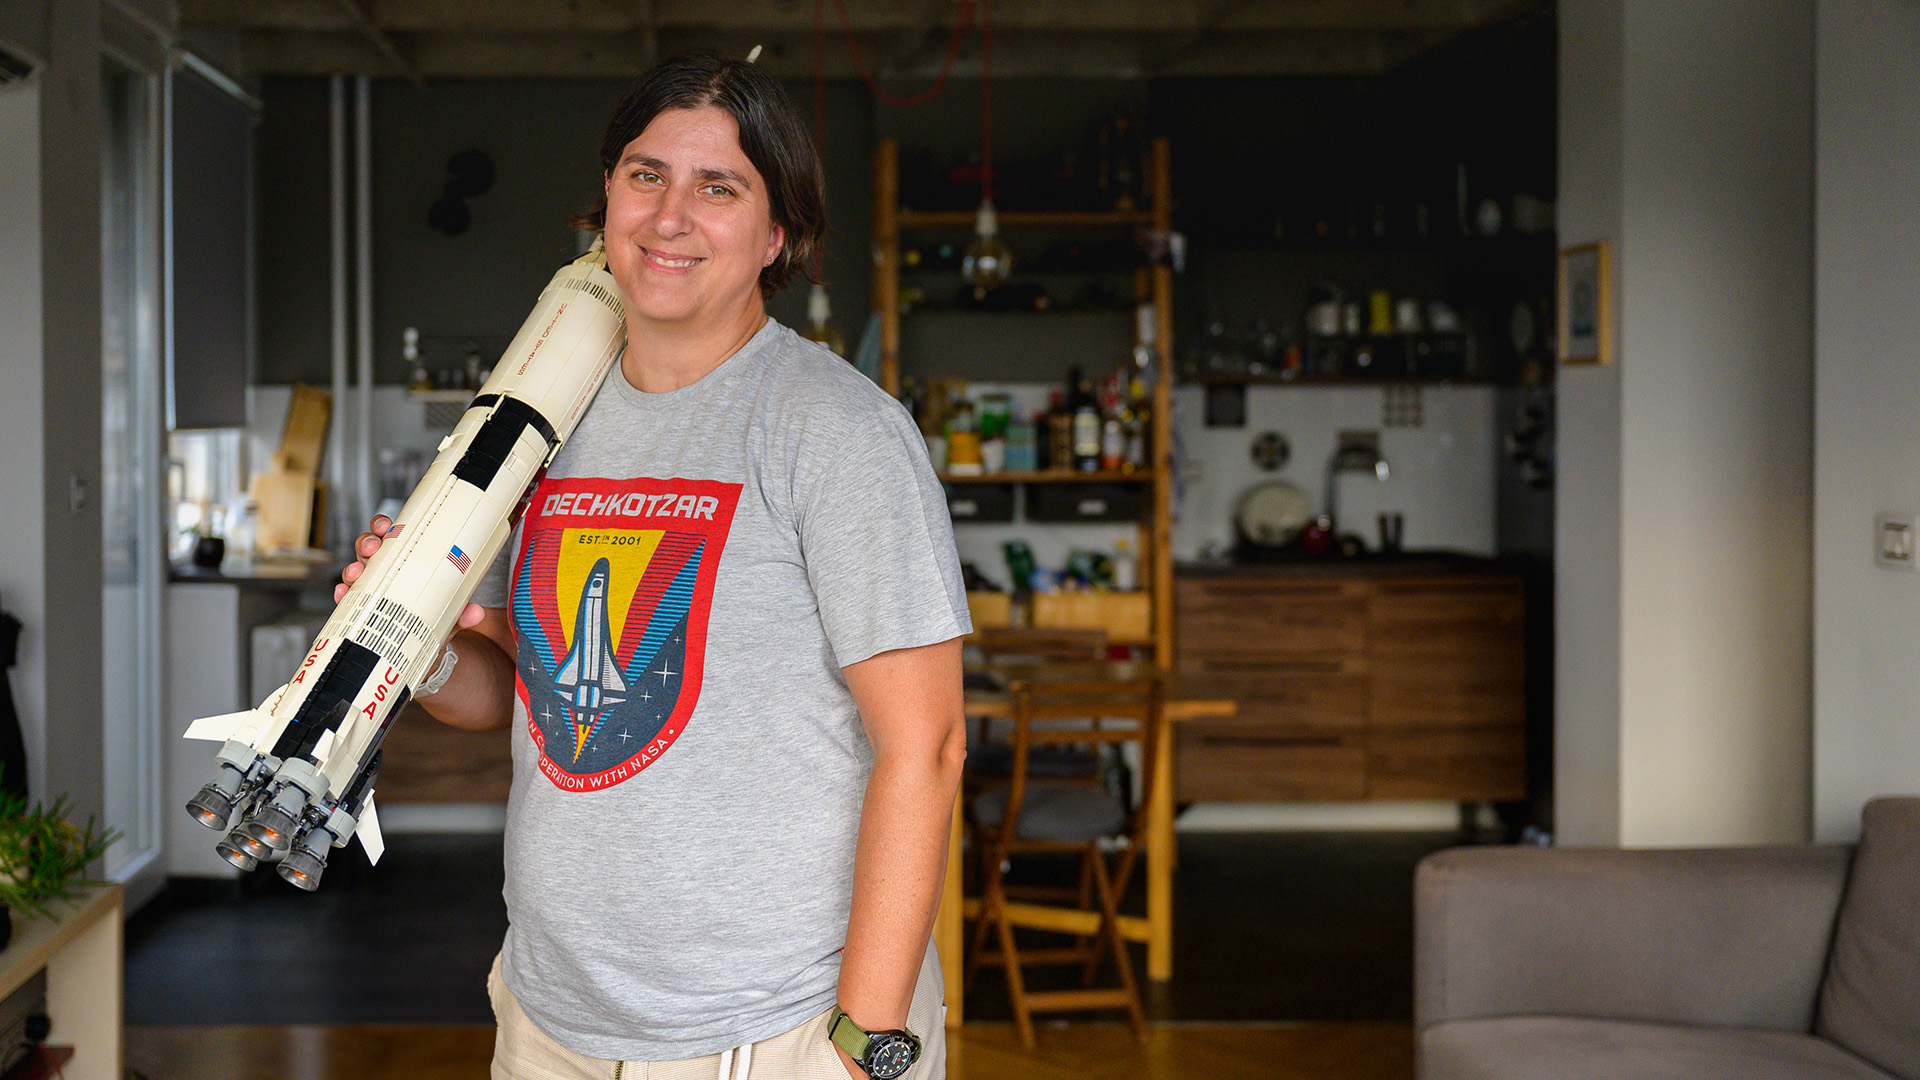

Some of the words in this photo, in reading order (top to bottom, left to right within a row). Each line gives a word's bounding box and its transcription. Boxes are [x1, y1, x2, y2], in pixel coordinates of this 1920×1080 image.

[542, 303, 568, 338] UNITED
[517, 339, 544, 376] STATES
[540, 492, 719, 521] DECHKOTZAR
[611, 536, 641, 546] 2001
[292, 638, 330, 685] USA
[362, 666, 400, 720] USA
[589, 766, 628, 788] WITH
[630, 738, 669, 772] NASA
